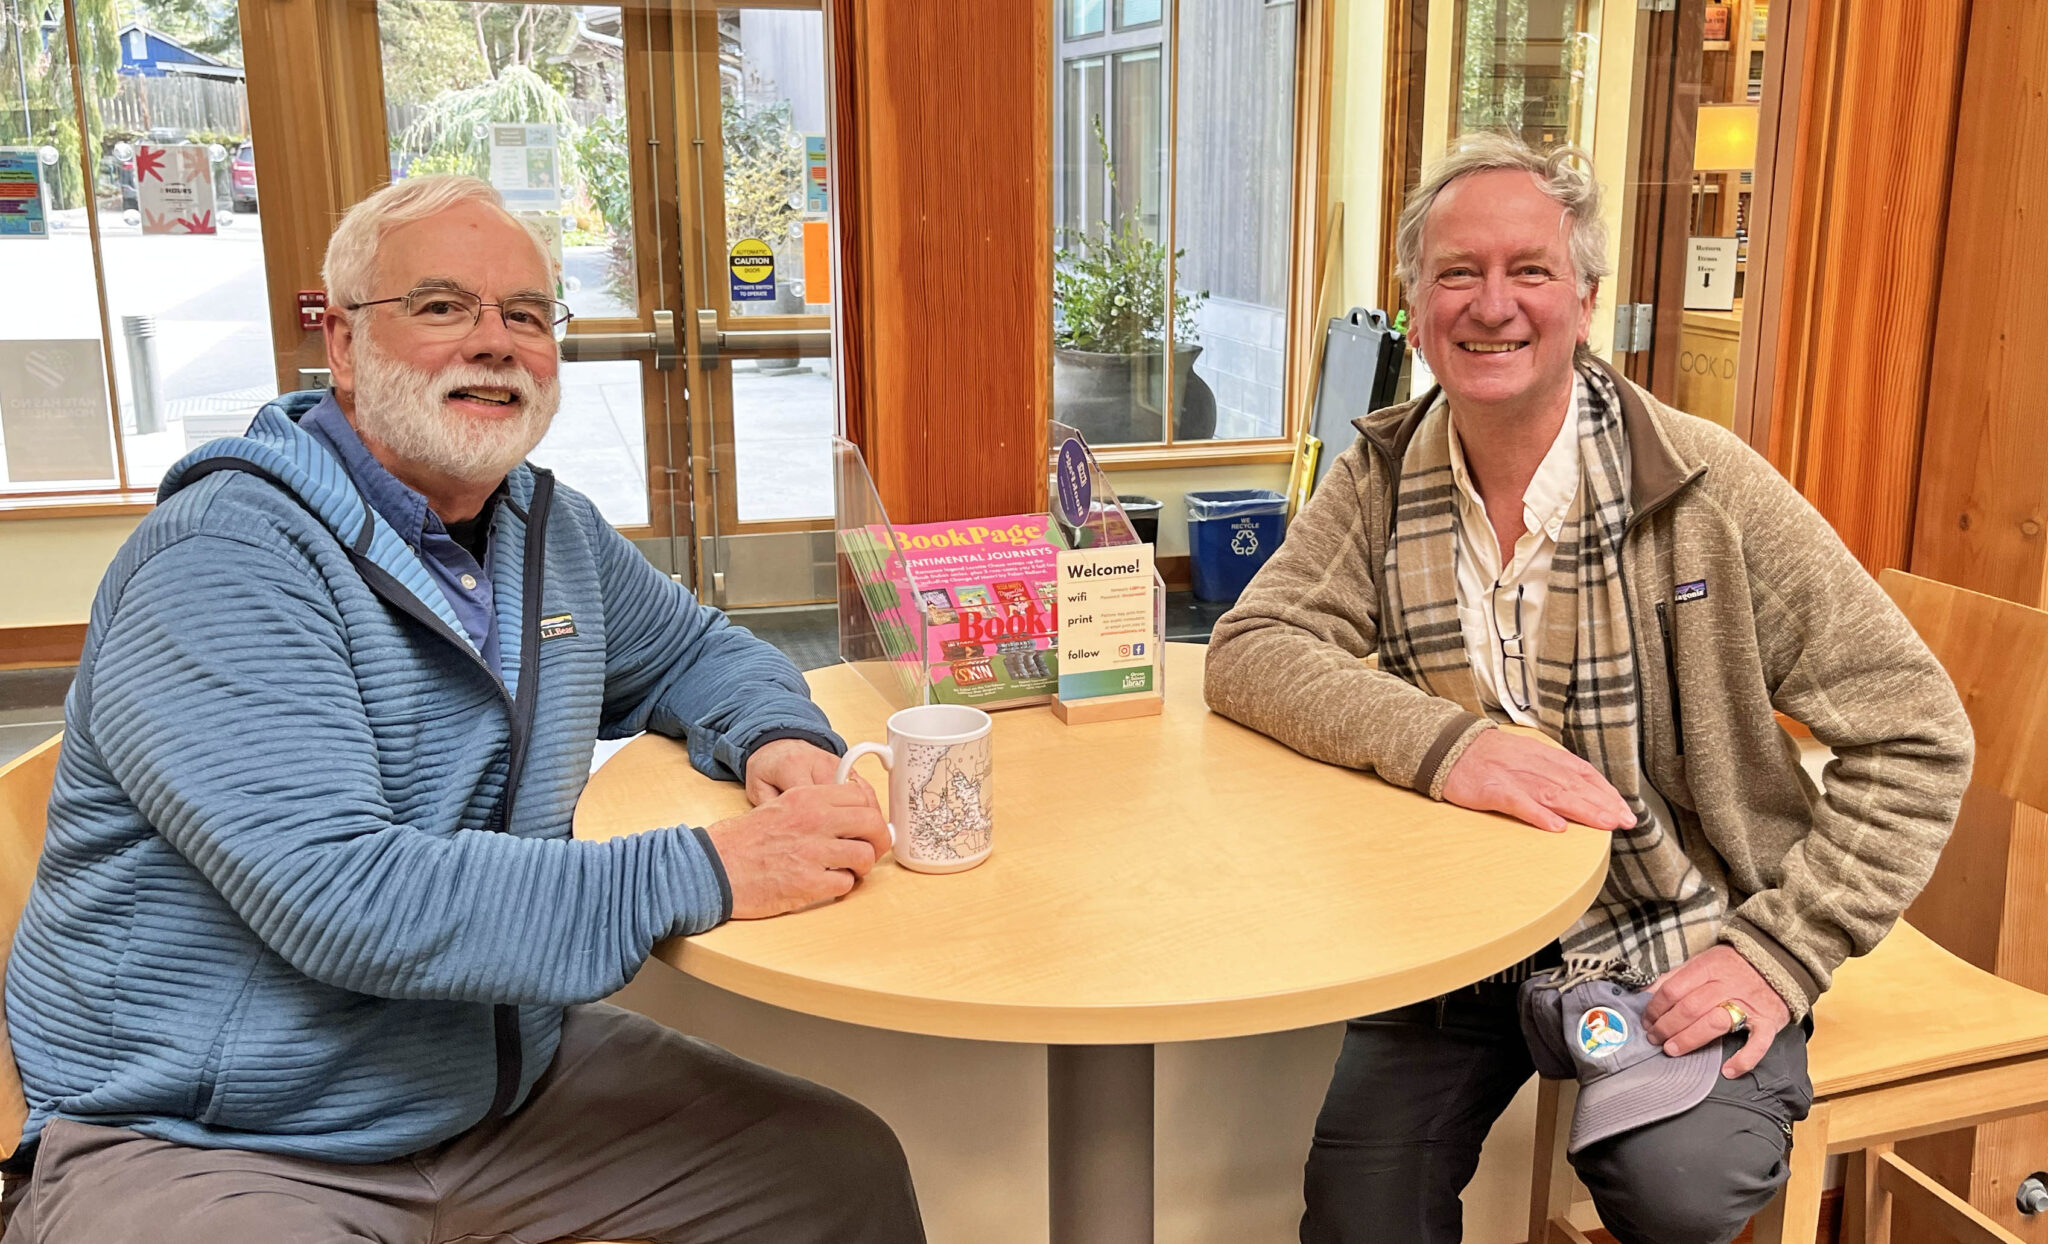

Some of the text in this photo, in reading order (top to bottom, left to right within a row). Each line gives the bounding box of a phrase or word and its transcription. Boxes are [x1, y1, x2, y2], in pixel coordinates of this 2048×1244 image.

[734, 257, 770, 265] CAUTION
[1680, 351, 1718, 378] OOK
[882, 524, 1042, 552] BookPage
[894, 546, 1053, 569] SENTIMENTAL JOURNEYS
[1067, 559, 1140, 578] Welcome!
[1067, 592, 1087, 603] wifi
[1067, 614, 1093, 628] print
[1067, 650, 1100, 660] follow
[1122, 679, 1146, 689] Library
